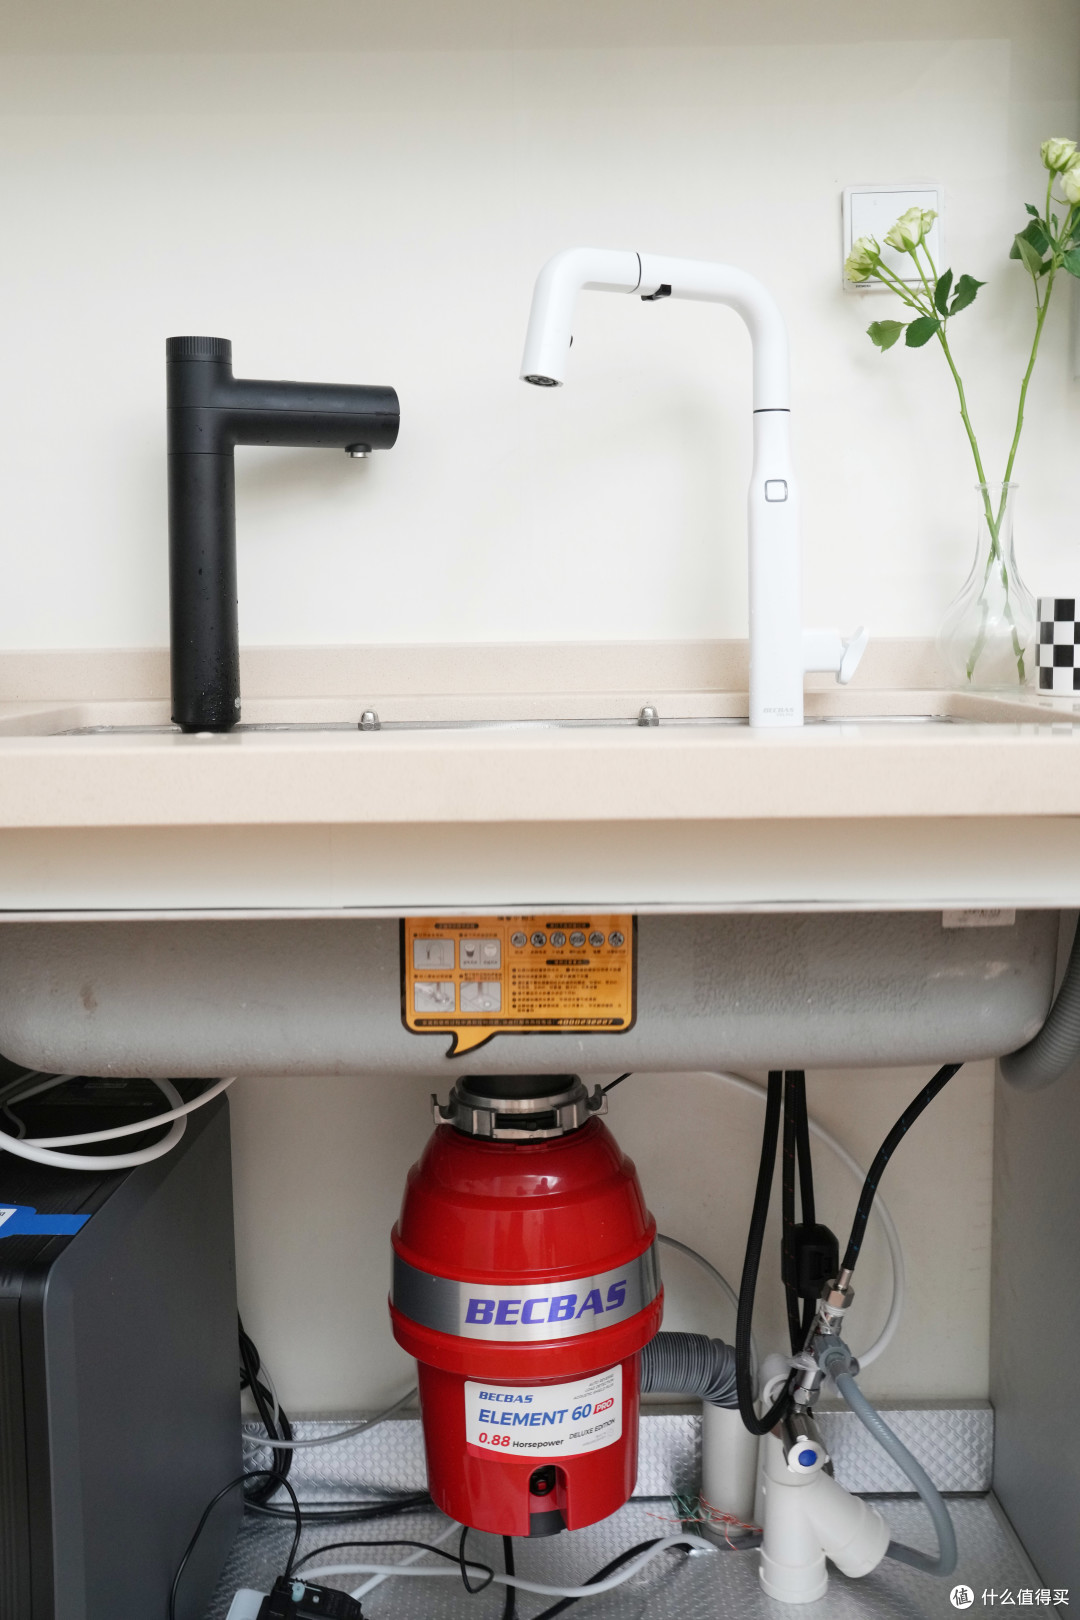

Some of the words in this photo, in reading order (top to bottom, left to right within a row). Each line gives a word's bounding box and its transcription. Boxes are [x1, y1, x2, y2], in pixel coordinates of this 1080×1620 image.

[465, 1280, 627, 1325] BECBAS
[479, 1391, 533, 1403] BECBAS
[478, 1409, 569, 1426] ELEMENT
[572, 1403, 592, 1421] 60
[596, 1399, 613, 1412] PRO
[569, 1428, 593, 1439] DELUXE
[595, 1418, 615, 1432] EDITION
[478, 1432, 511, 1447] 0.88
[512, 1440, 564, 1449] Horsepower
